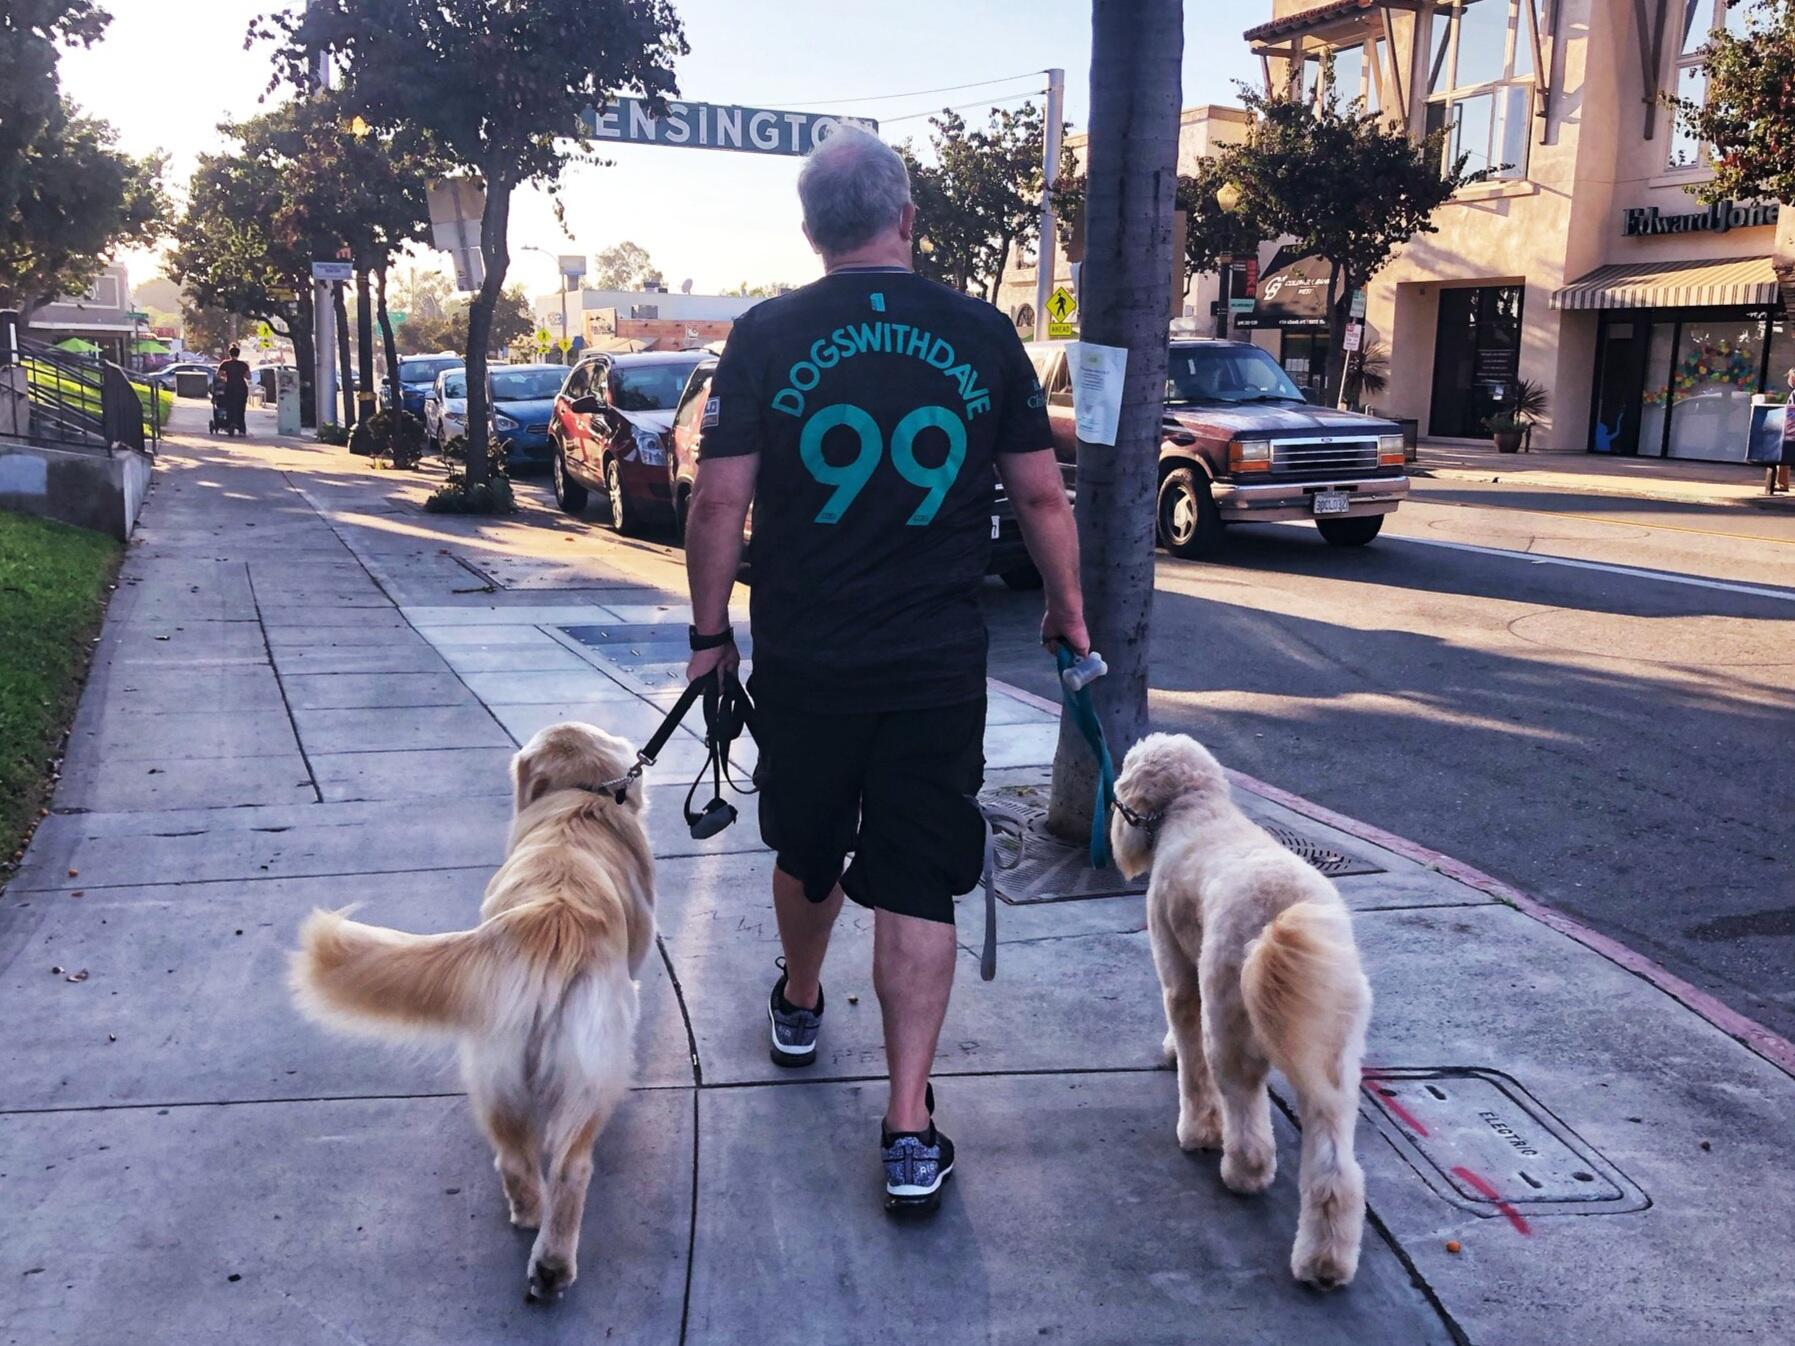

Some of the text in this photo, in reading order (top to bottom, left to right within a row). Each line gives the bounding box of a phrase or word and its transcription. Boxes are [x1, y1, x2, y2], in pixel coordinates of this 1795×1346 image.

[595, 98, 874, 150] ENSINGTO
[1714, 200, 1779, 233] Jone
[1051, 325, 1070, 333] AHEAD
[771, 321, 991, 420] DOGSWITHDAVE
[800, 404, 967, 526] 99
[1478, 1111, 1538, 1156] ELECTRIC
